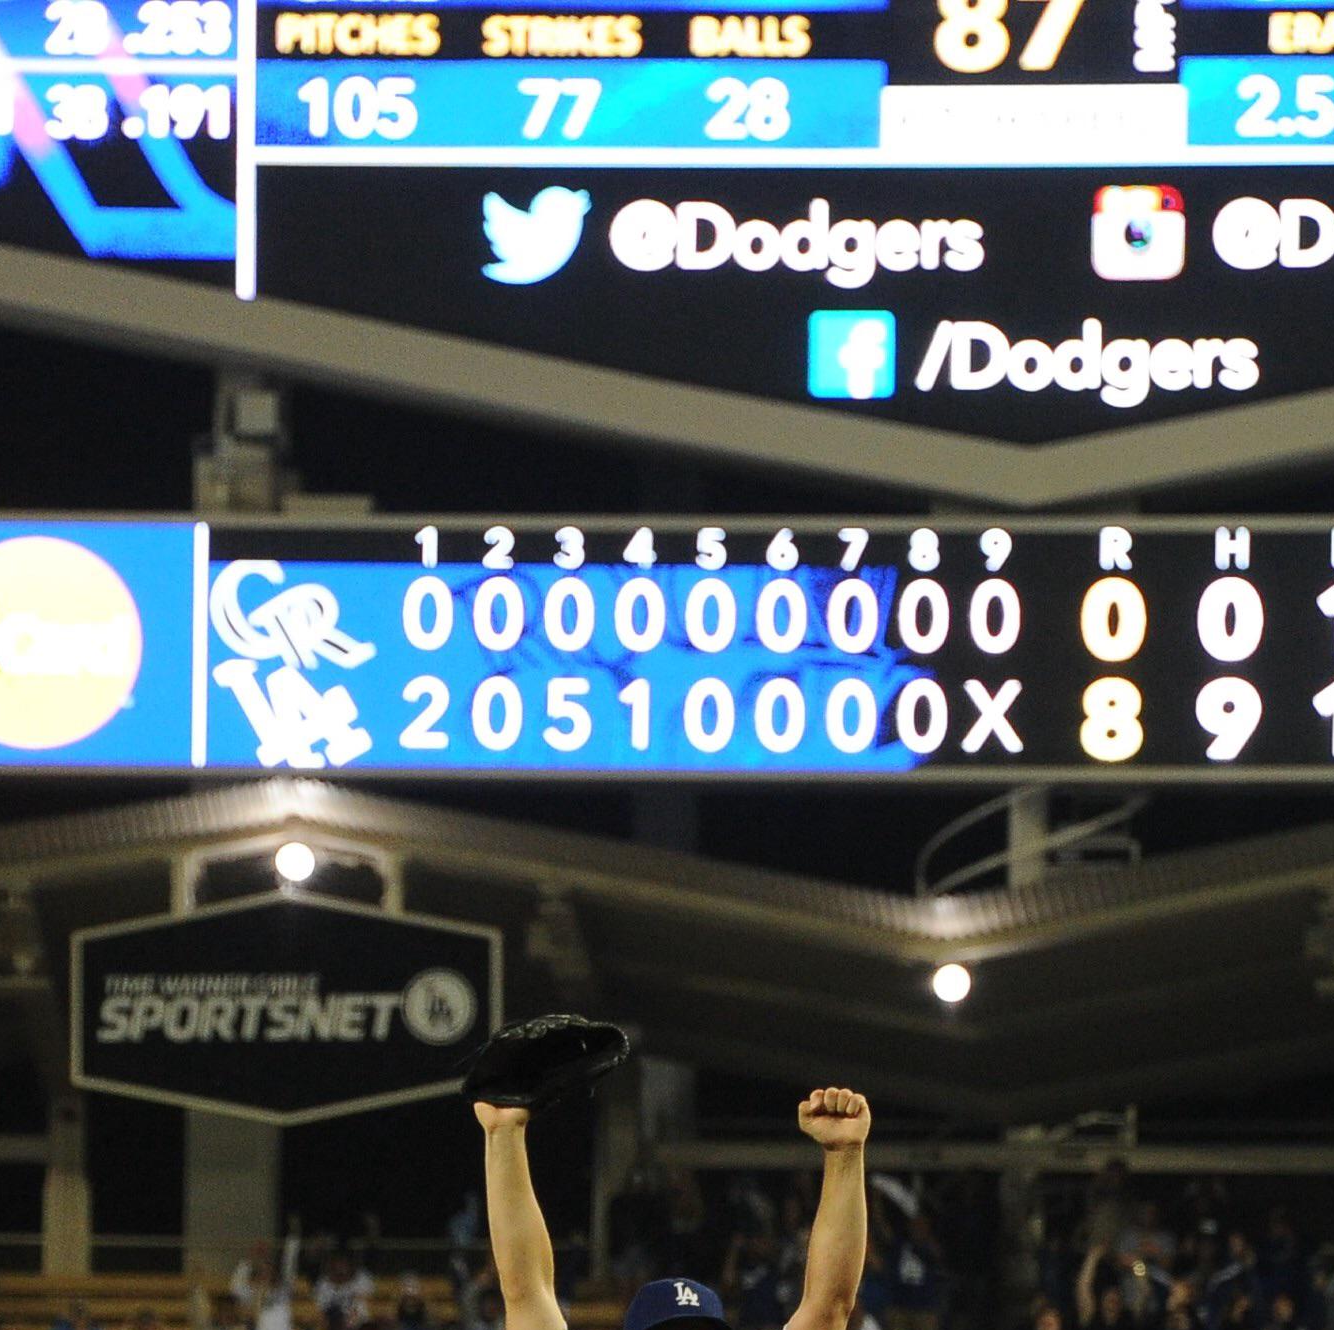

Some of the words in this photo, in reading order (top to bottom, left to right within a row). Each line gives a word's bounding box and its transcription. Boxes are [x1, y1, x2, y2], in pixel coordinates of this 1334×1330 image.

[275, 12, 441, 57] PITCHES
[481, 14, 643, 58] STRIKES
[689, 14, 811, 58] BALLS
[933, 0, 1087, 74] 87
[121, 83, 231, 140] .191
[298, 75, 418, 140] 105
[517, 77, 603, 140] 77
[703, 77, 790, 141] 28
[608, 198, 986, 289] @Dodgers
[914, 318, 1259, 408] /Dodgers
[414, 526, 438, 570] 1
[483, 526, 515, 570] 2
[553, 526, 586, 570] 3
[622, 526, 657, 570] 4
[696, 526, 727, 570] 5
[765, 526, 799, 570] 6
[838, 526, 869, 570] 7
[908, 526, 940, 570] 8
[978, 526, 1013, 570] 9
[1098, 526, 1133, 570] R
[1214, 526, 1251, 570] H
[403, 576, 453, 654] 0
[473, 577, 524, 654] 0
[544, 577, 594, 654] 0
[614, 577, 666, 654] 0
[685, 577, 737, 654] 0
[756, 577, 807, 654] 0
[827, 577, 879, 654] 0
[898, 577, 949, 654] 0
[969, 577, 1021, 654] 0
[1080, 576, 1148, 662] 0
[1196, 576, 1265, 662] 0
[399, 675, 450, 753] 2
[471, 675, 523, 753] 0
[543, 675, 592, 753] 5
[618, 675, 650, 753] 1
[683, 675, 735, 753] 0
[754, 675, 806, 753] 0
[825, 675, 877, 753] 0
[896, 675, 948, 753] 0
[961, 675, 1023, 753] X
[1079, 675, 1144, 763] 8
[1195, 675, 1263, 762] 9
[97, 992, 403, 1043] SPORTSNET
[673, 1282, 701, 1307] LA
